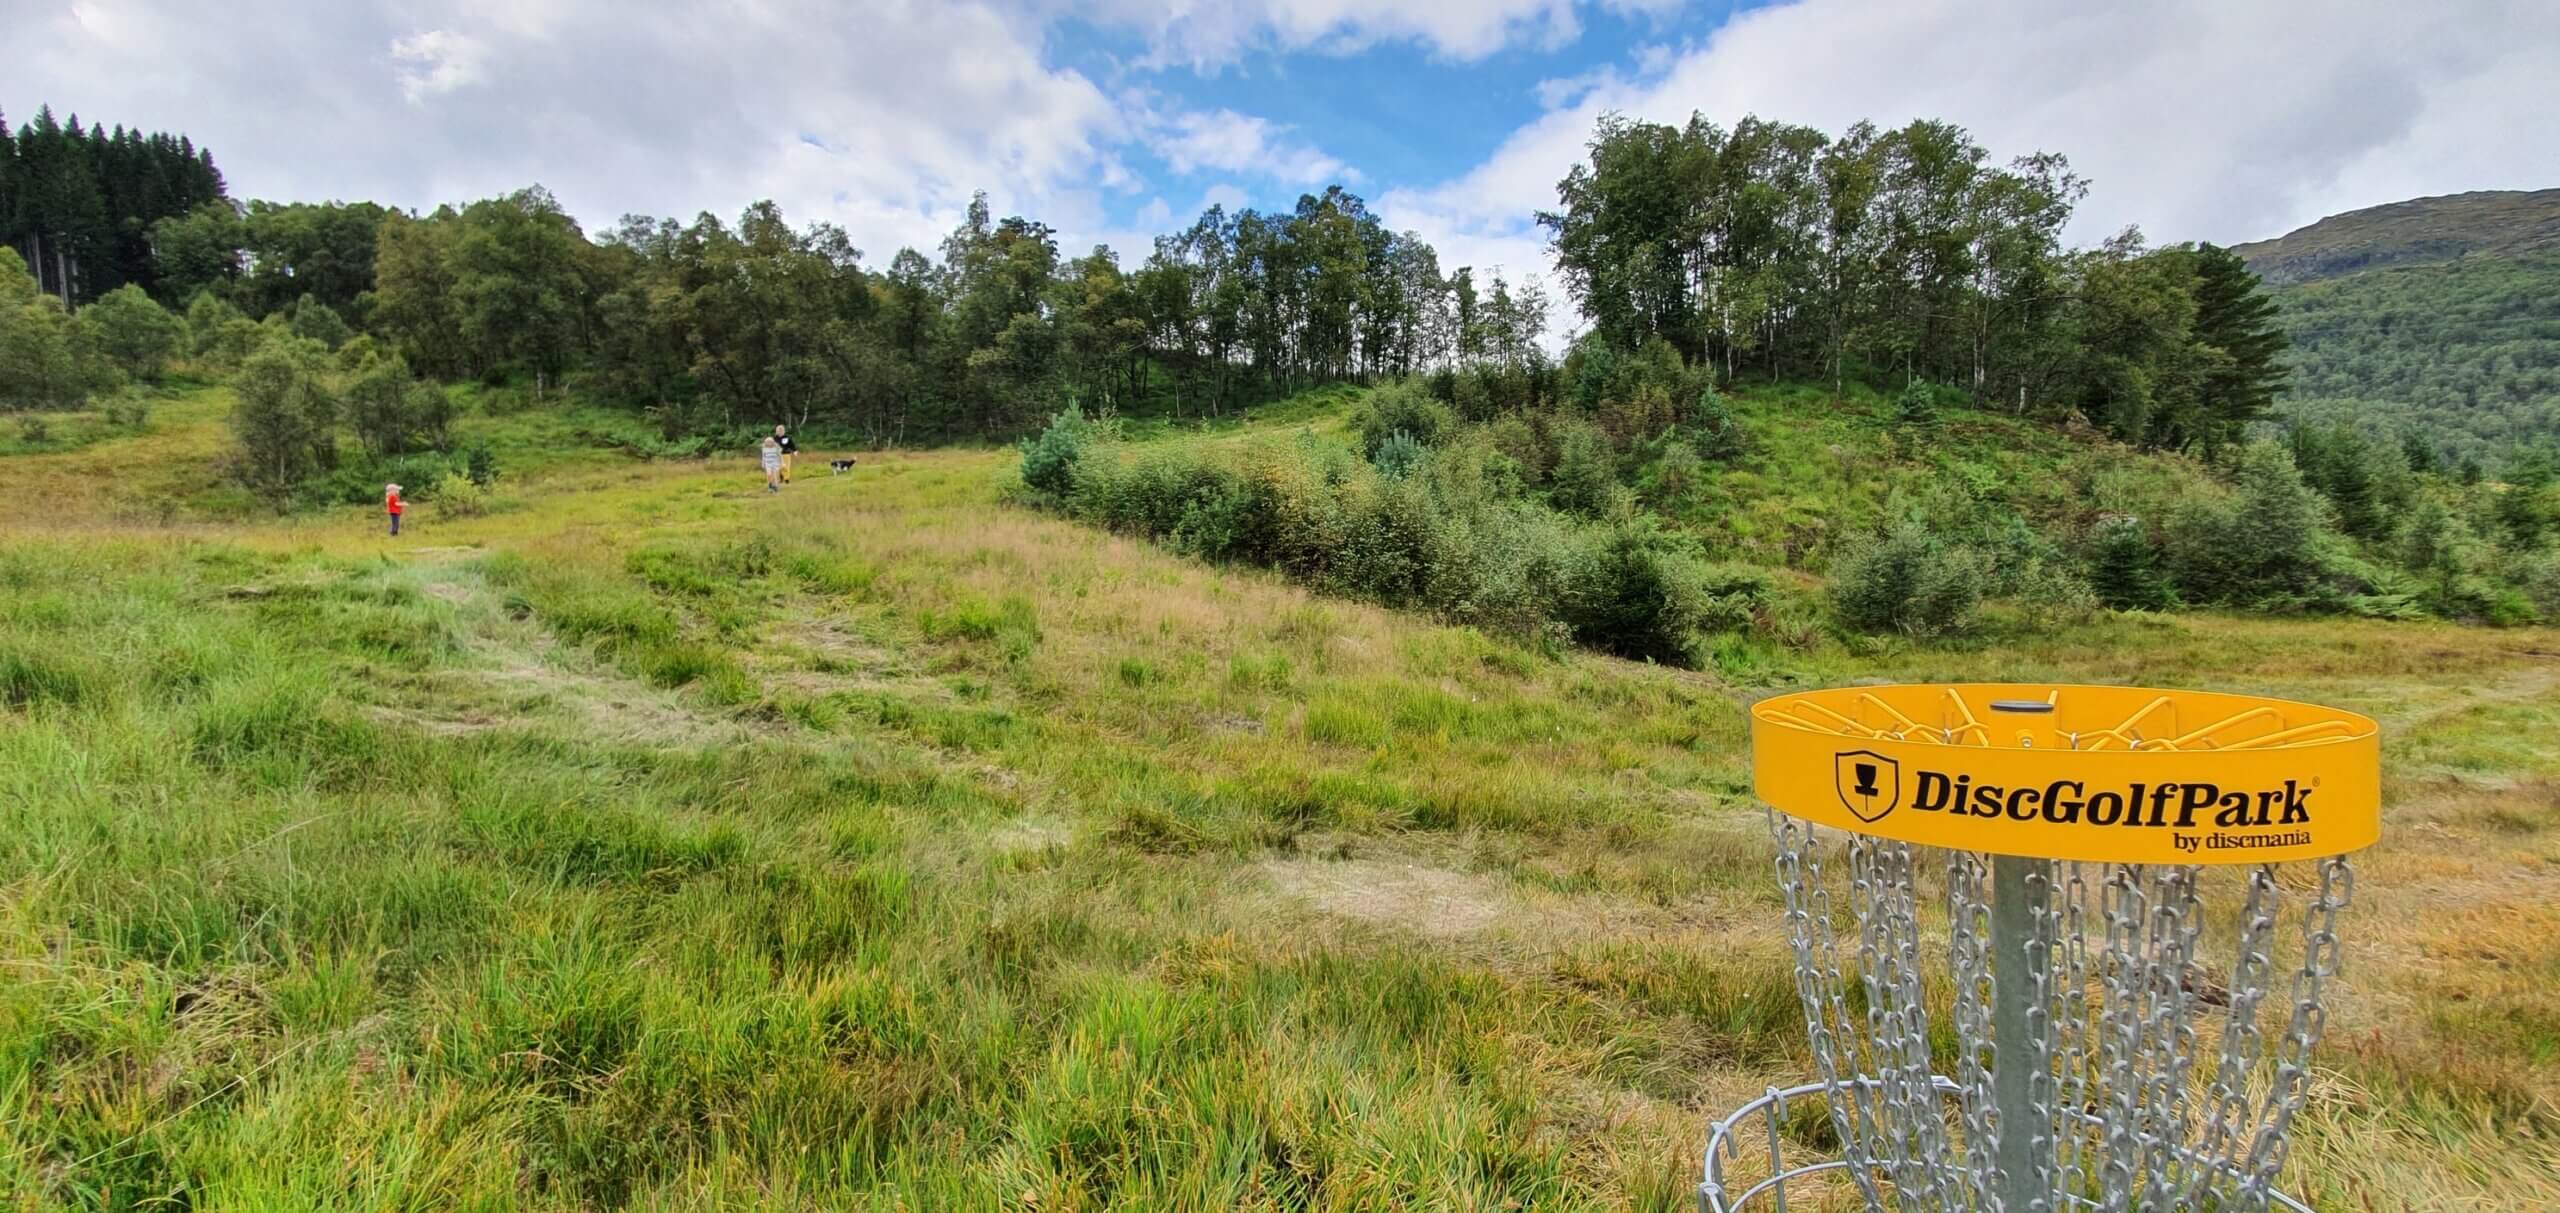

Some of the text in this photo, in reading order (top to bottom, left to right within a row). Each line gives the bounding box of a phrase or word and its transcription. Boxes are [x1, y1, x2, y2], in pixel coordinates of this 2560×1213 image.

[1911, 771, 2312, 828] DiscGolfPark
[2173, 829, 2312, 853] by discmania
